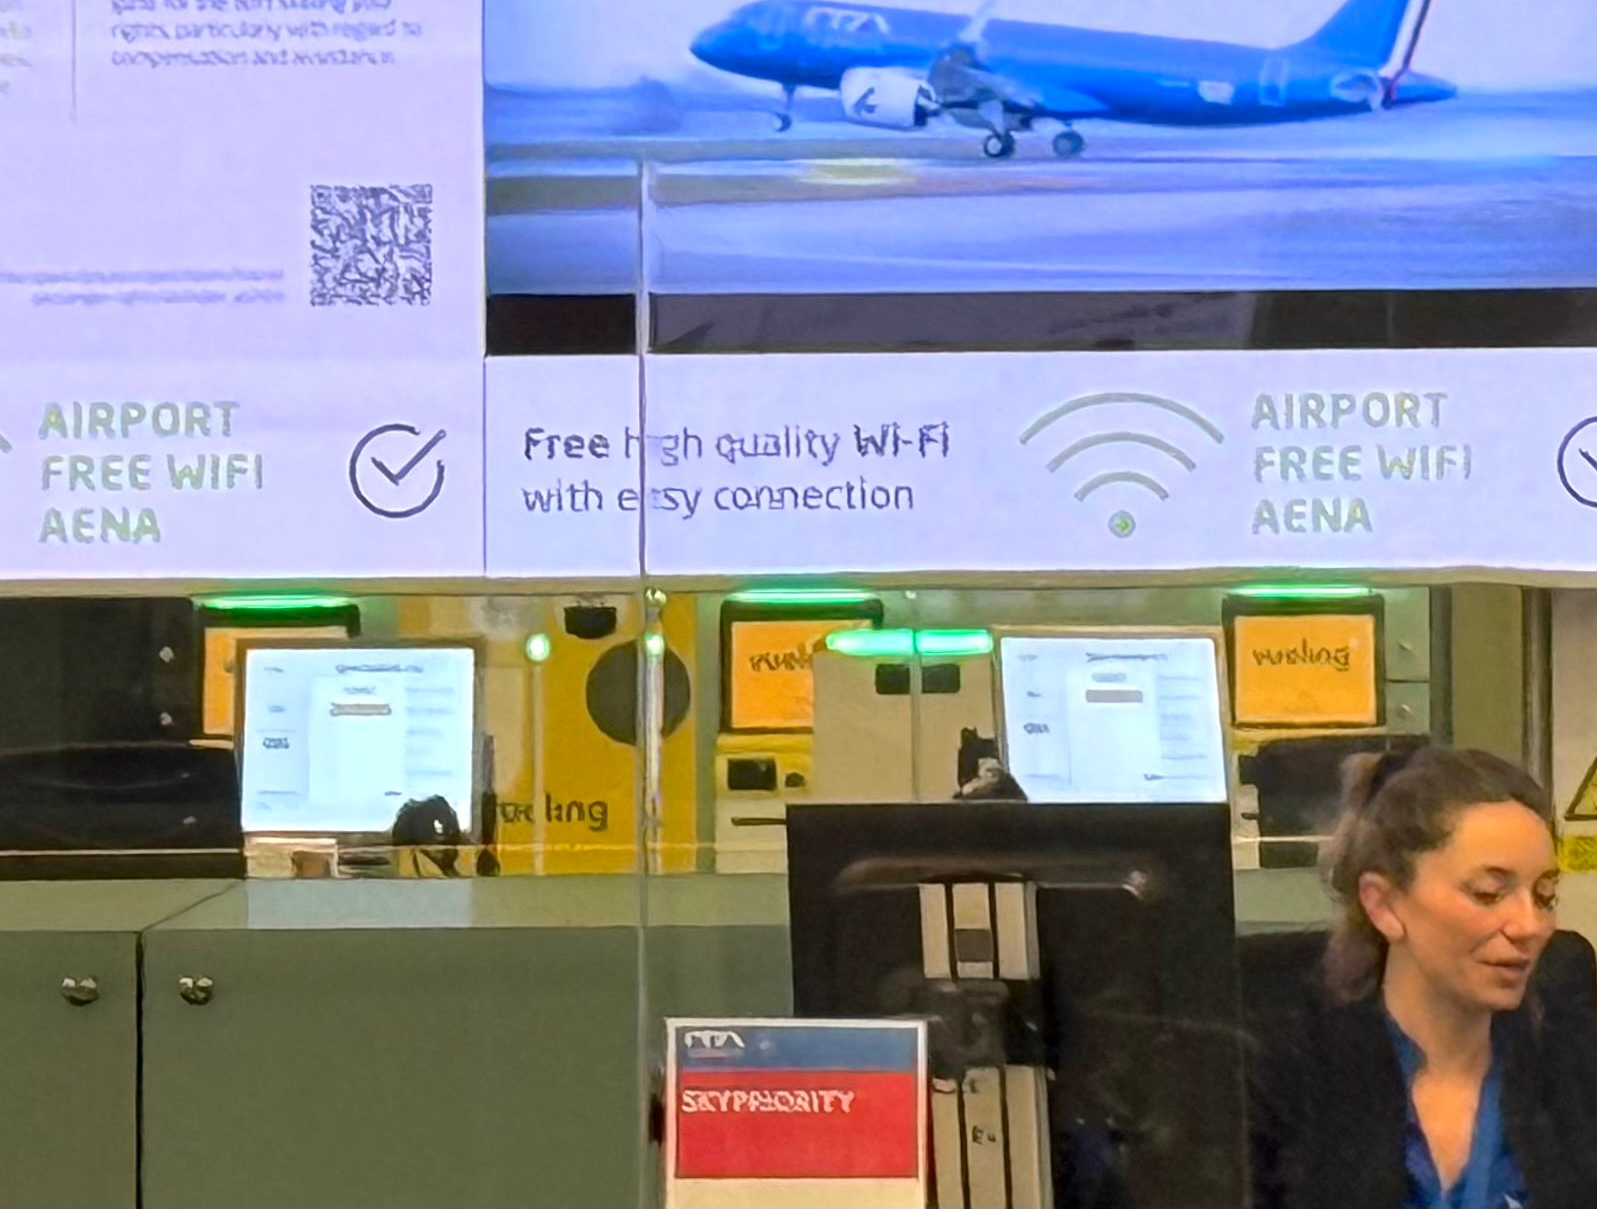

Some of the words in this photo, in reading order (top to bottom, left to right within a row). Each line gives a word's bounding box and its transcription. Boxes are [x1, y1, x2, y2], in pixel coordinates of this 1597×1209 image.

[39, 401, 240, 440] AIRPORT
[1252, 392, 1448, 430] AIRPORT
[524, 426, 610, 460] Free
[624, 425, 702, 467] hgh
[716, 426, 841, 467] quality
[1254, 445, 1363, 482] FREE
[1378, 443, 1472, 480] WIFI
[41, 454, 152, 491] FREE
[167, 453, 263, 490] WIFI
[522, 478, 603, 512] with
[714, 475, 914, 511] connection
[39, 506, 162, 544] AENA
[1252, 497, 1373, 535] AENA
